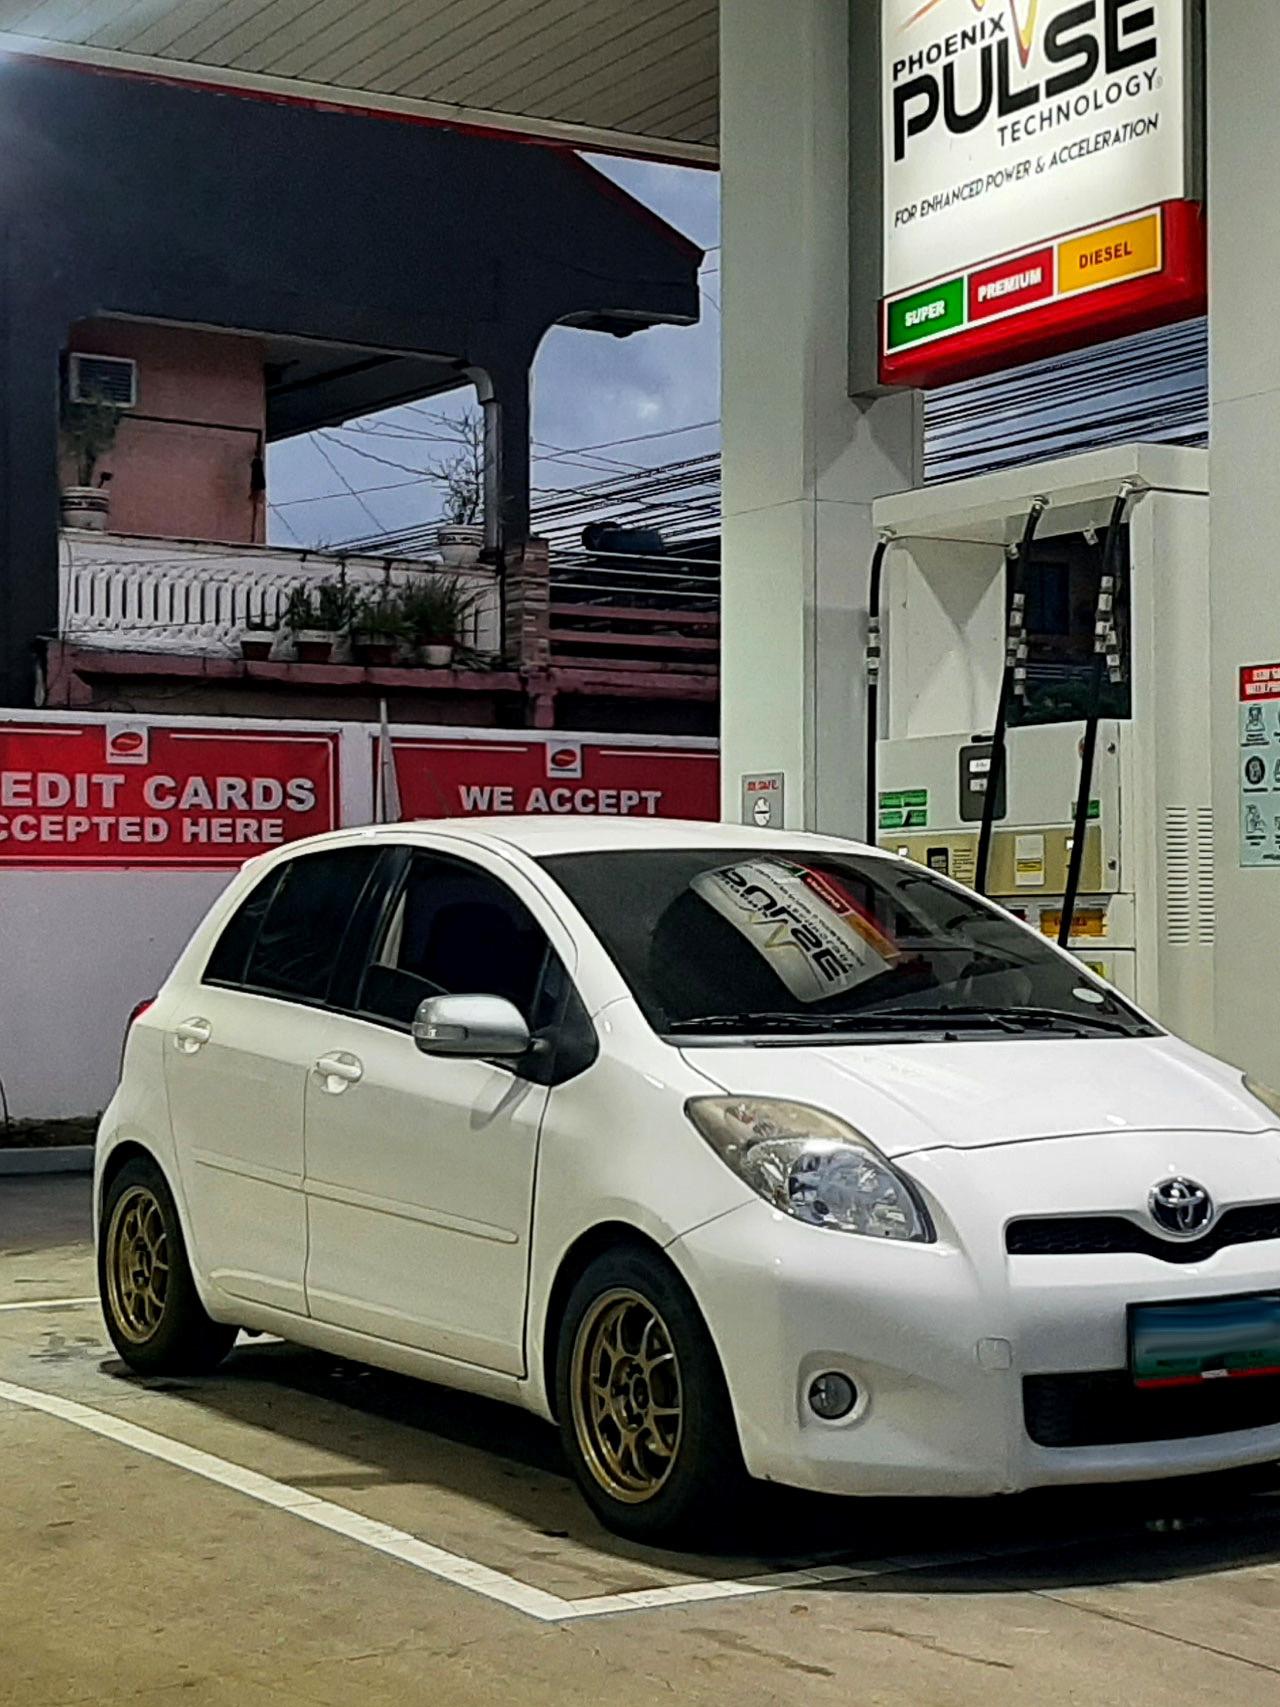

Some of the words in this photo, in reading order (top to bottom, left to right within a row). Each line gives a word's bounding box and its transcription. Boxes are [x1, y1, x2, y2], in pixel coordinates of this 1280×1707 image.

[893, 13, 1006, 81] PHOENIX
[893, 0, 1158, 162] PULSE
[997, 68, 1158, 146] TECHNOLOGY
[894, 206, 918, 228] FOR
[920, 178, 985, 219] ENHANCED
[985, 159, 1031, 194] POWER
[1035, 158, 1046, 175] &
[1049, 114, 1160, 169] ACCELERATION
[904, 300, 945, 327] SUPER
[977, 267, 1042, 303] PREMIUM
[1078, 241, 1133, 270] DIESEL
[1, 771, 126, 809] EDIT
[142, 774, 316, 812] CARDS
[458, 784, 514, 812] WE
[525, 786, 661, 816] ACCEPT
[182, 816, 284, 844] HERE
